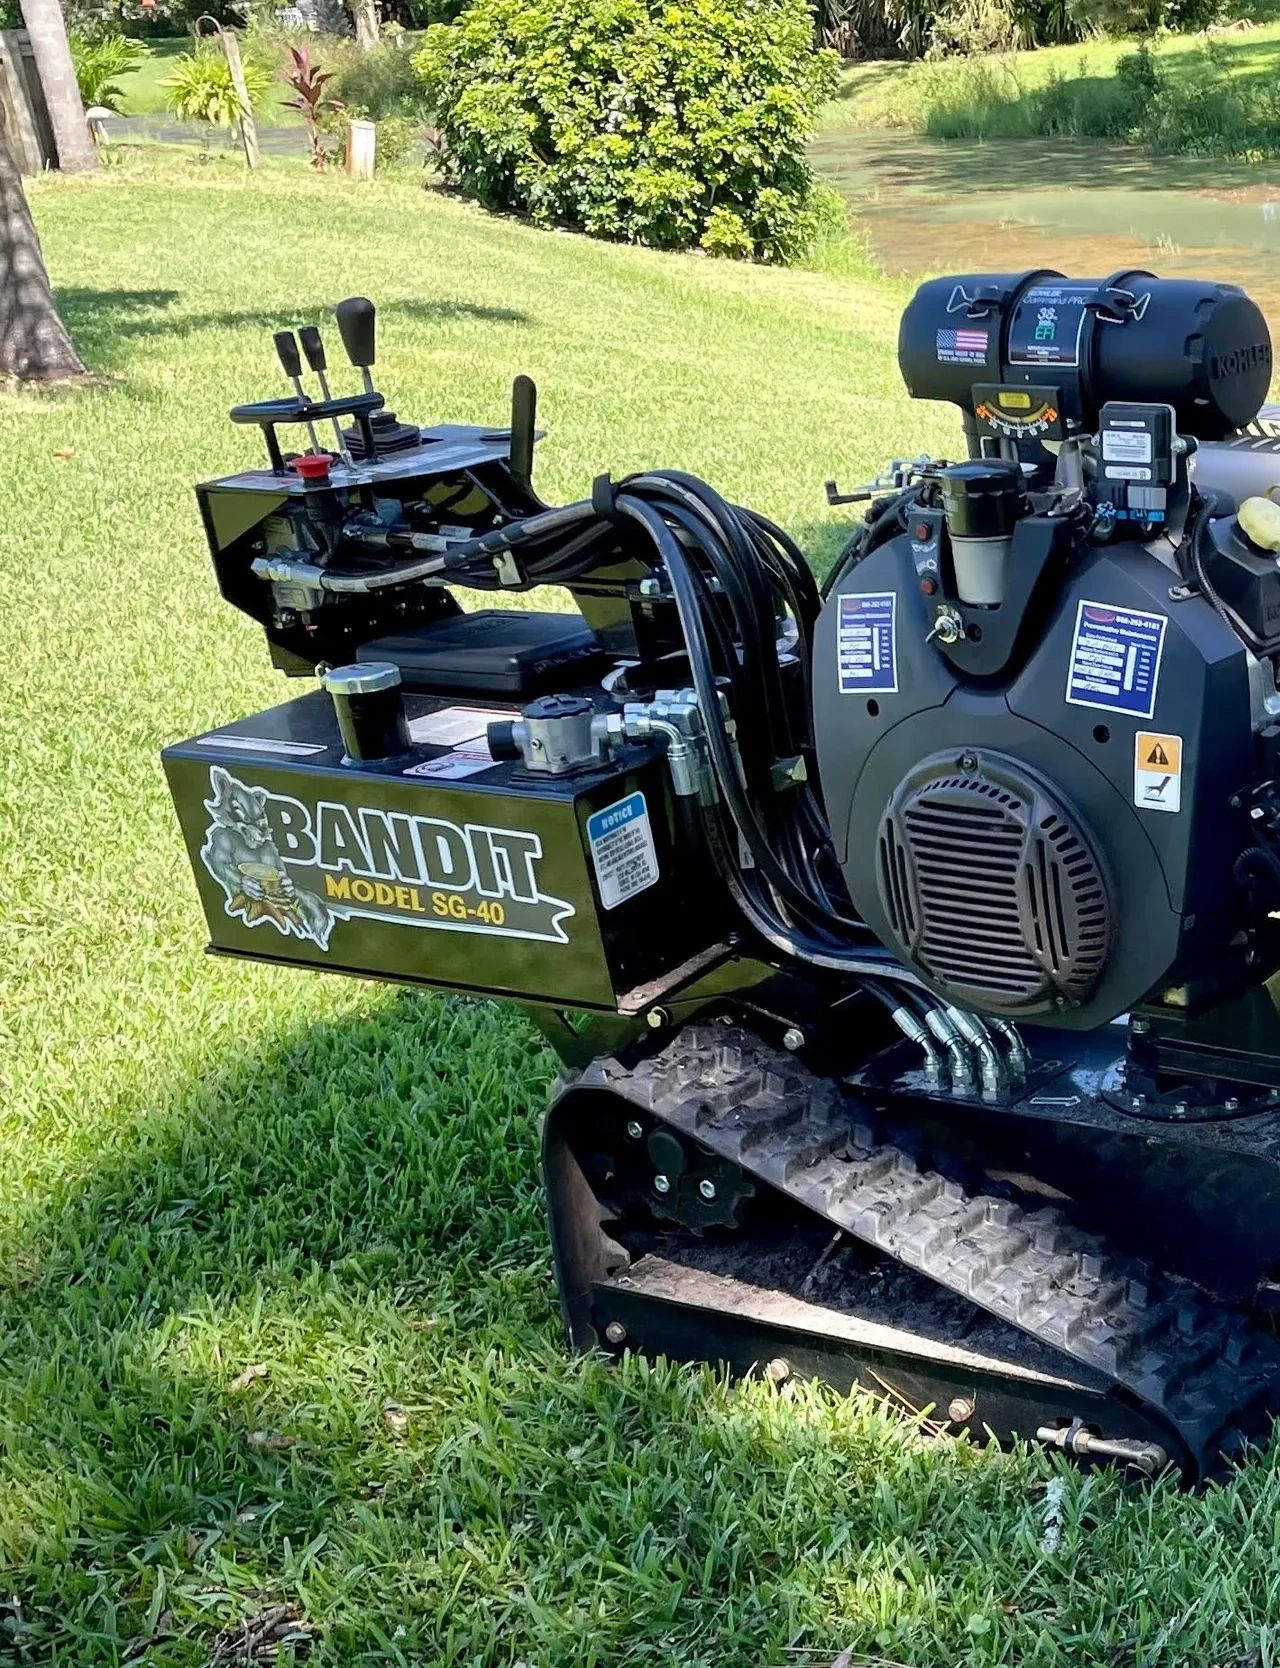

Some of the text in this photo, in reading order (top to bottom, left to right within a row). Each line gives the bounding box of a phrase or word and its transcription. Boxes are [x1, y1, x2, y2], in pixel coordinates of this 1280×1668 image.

[1035, 326, 1054, 340] EFI
[601, 804, 633, 829] NOTICE
[270, 794, 543, 904] BANDIT
[325, 873, 505, 926] MODEL SG-40
